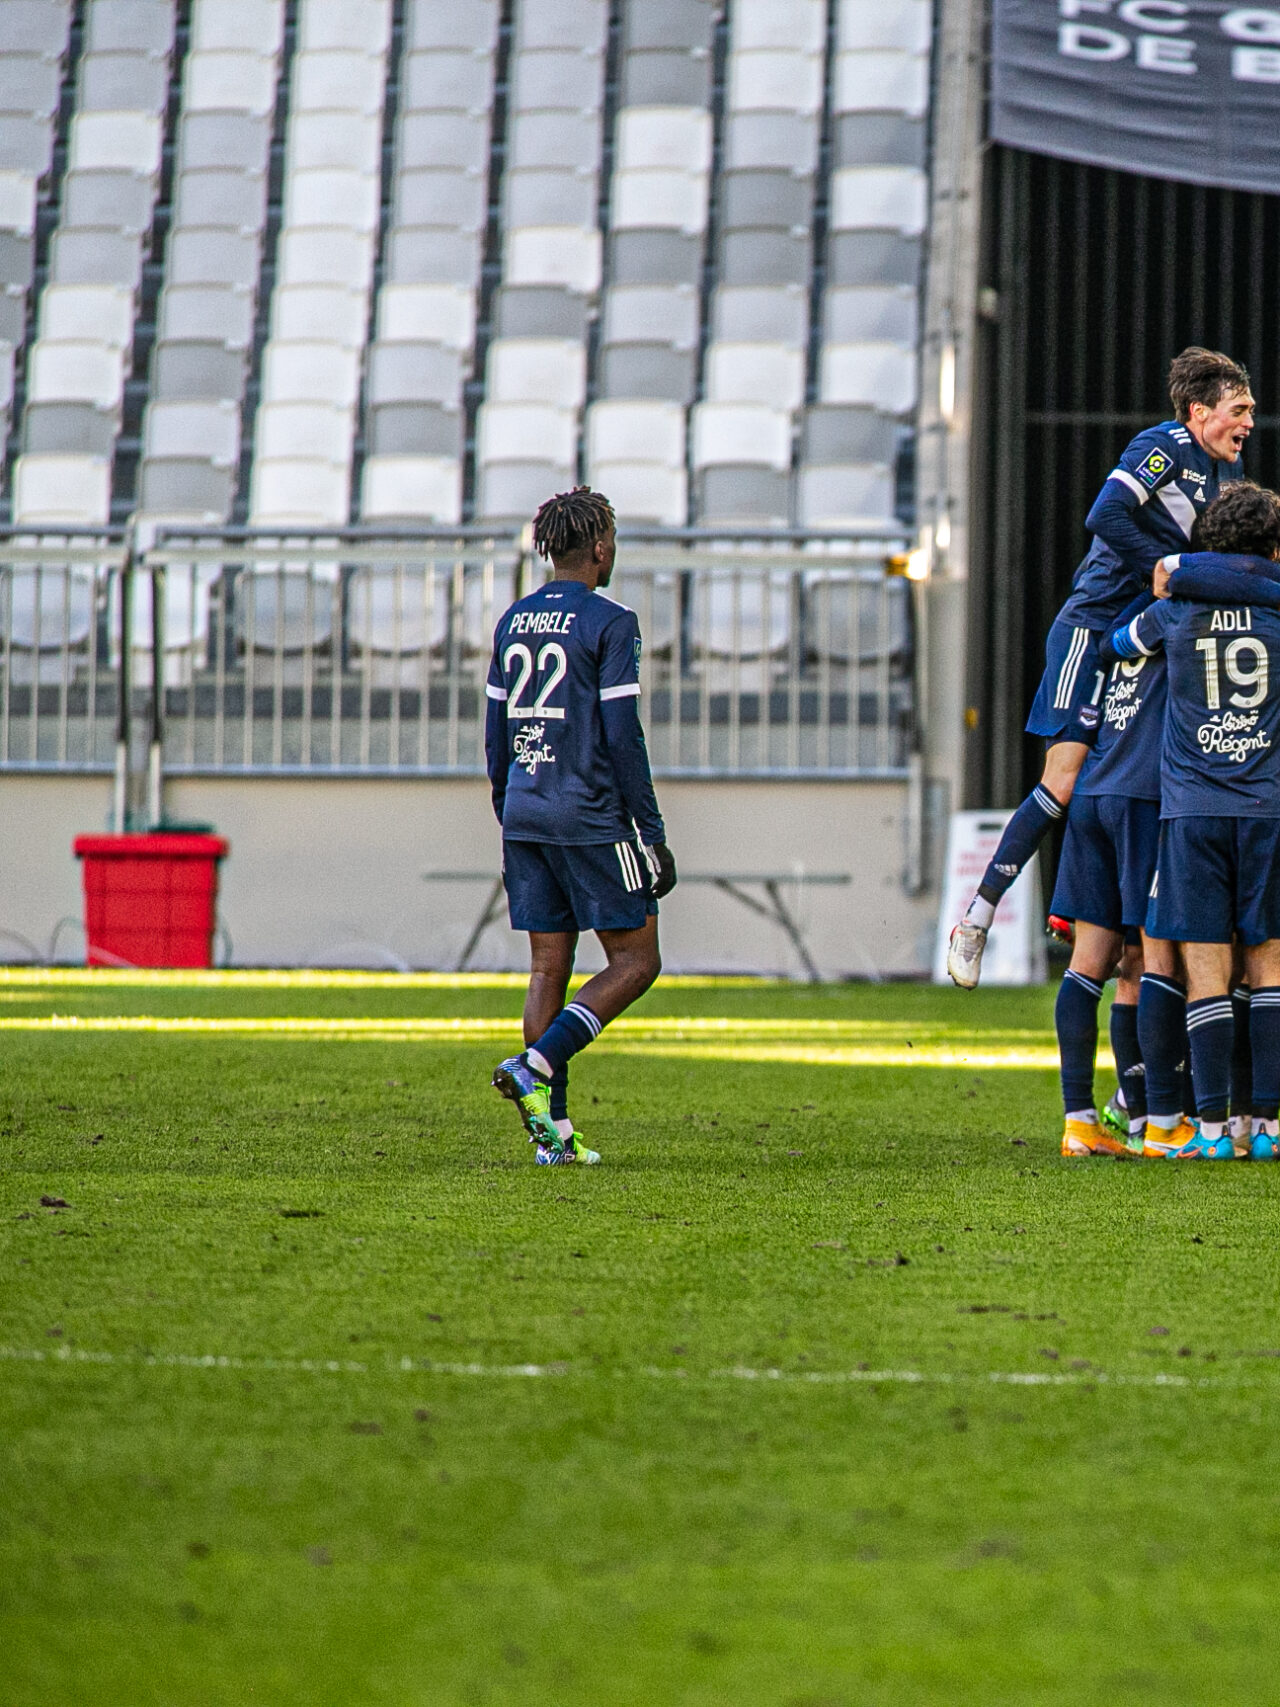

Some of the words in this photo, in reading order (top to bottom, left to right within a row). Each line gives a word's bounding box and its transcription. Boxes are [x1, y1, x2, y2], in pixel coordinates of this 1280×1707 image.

[1057, 21, 1199, 75] DE
[508, 611, 577, 635] PEMBELE
[1210, 607, 1252, 632] ADLI
[503, 641, 568, 720] 22
[1195, 636, 1269, 710] 19
[1197, 723, 1272, 763] Régent
